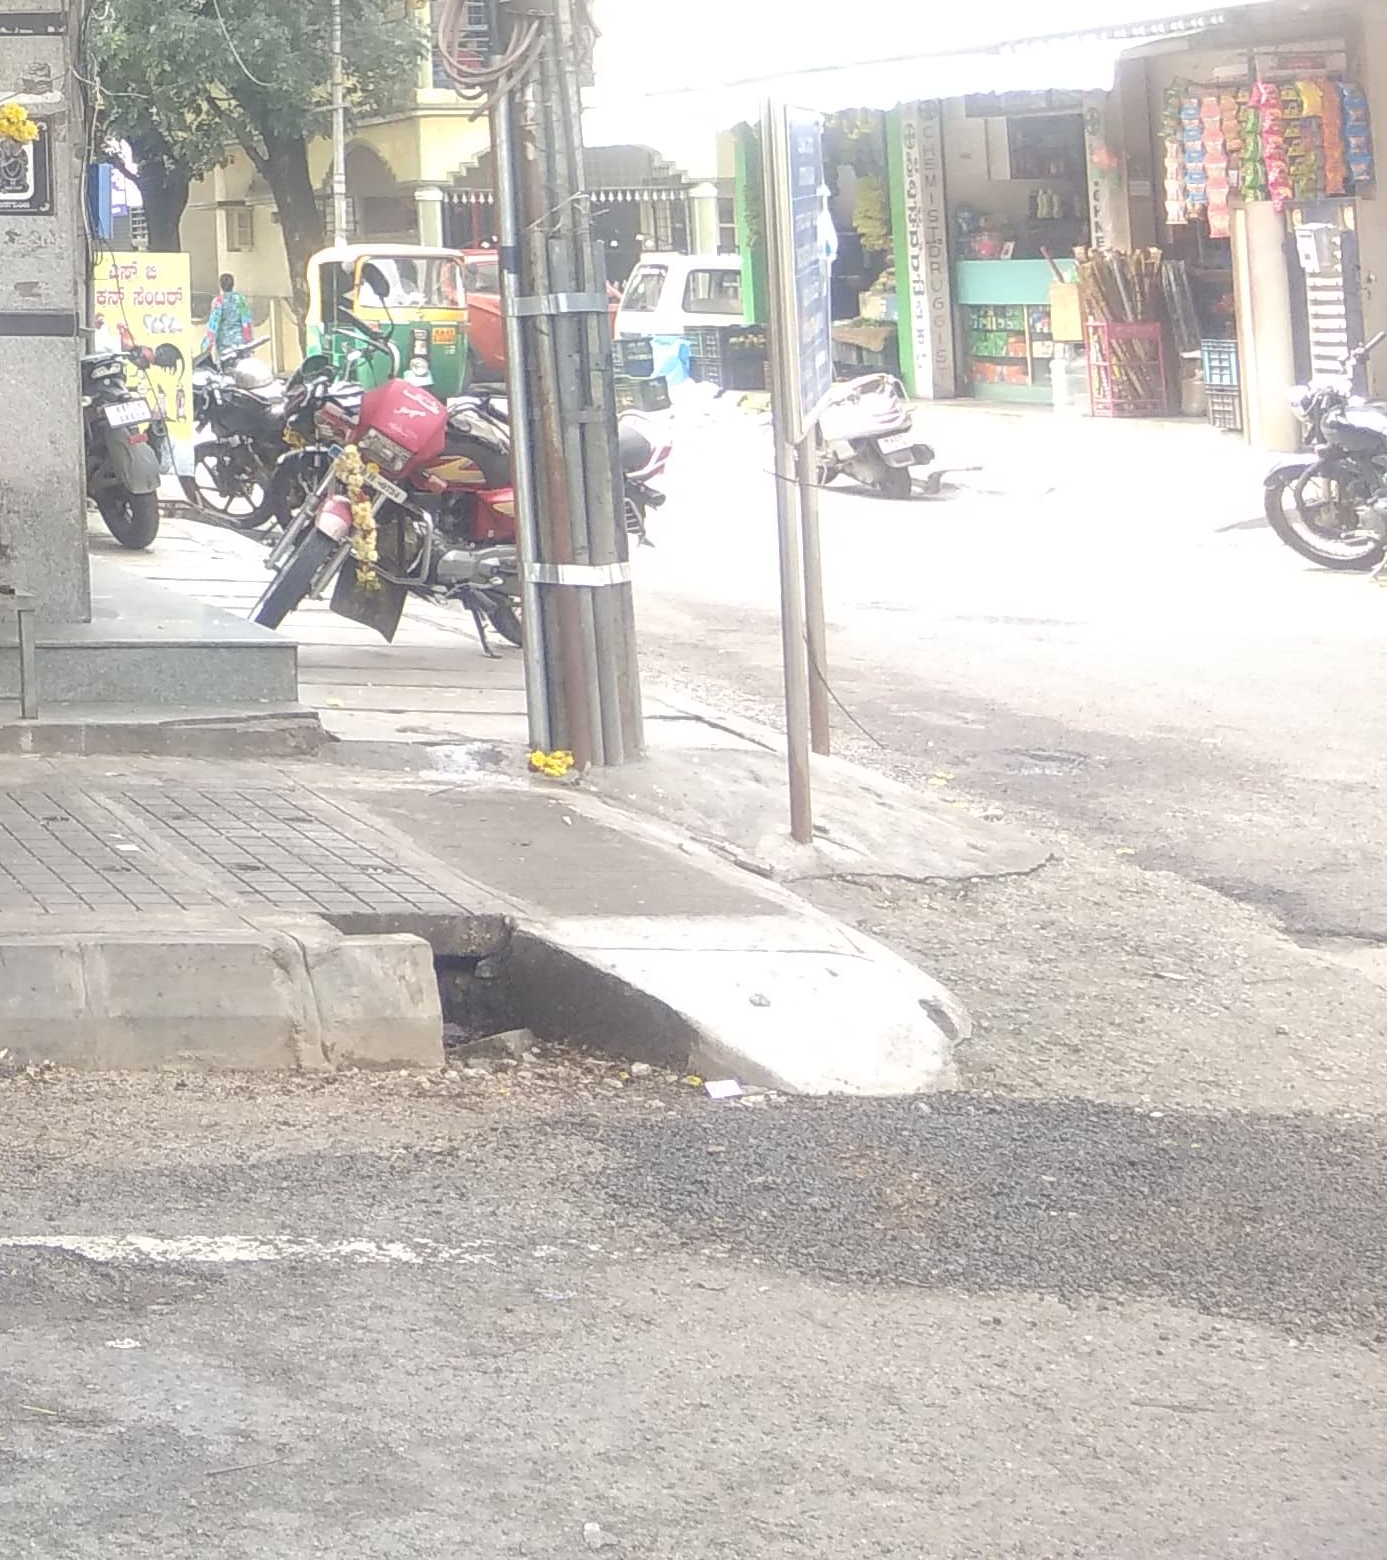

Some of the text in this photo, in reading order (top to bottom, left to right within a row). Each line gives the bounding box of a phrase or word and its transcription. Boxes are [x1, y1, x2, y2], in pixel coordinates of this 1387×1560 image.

[921, 124, 940, 238] CHEMIST
[95, 287, 125, 307] ಕನ್
[929, 246, 949, 379] DRUGGIS
